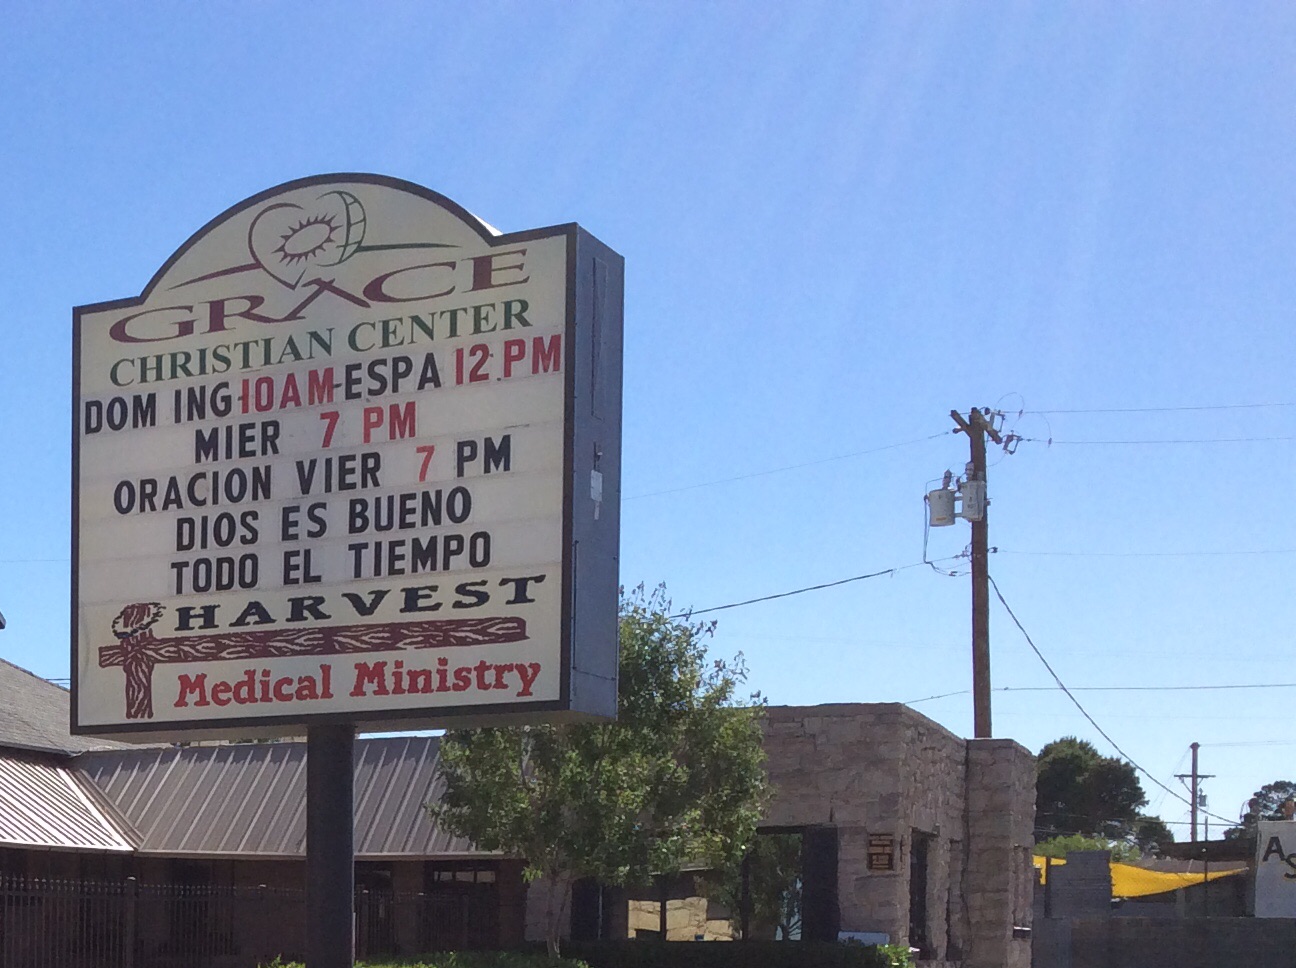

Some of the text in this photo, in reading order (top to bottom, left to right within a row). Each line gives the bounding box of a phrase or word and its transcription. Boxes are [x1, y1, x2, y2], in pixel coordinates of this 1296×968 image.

[109, 249, 530, 342] GRACE
[110, 299, 533, 386] CHRISTIAN CENTER
[195, 401, 416, 463] MIER 7 PM
[114, 435, 511, 514] ORACION VIER 7 PM
[176, 486, 472, 551] DIOS ES BUENO
[171, 531, 491, 594] TODO EL TIEMPO
[174, 574, 546, 631] HARVEST
[174, 657, 541, 707] Medical Ministry
